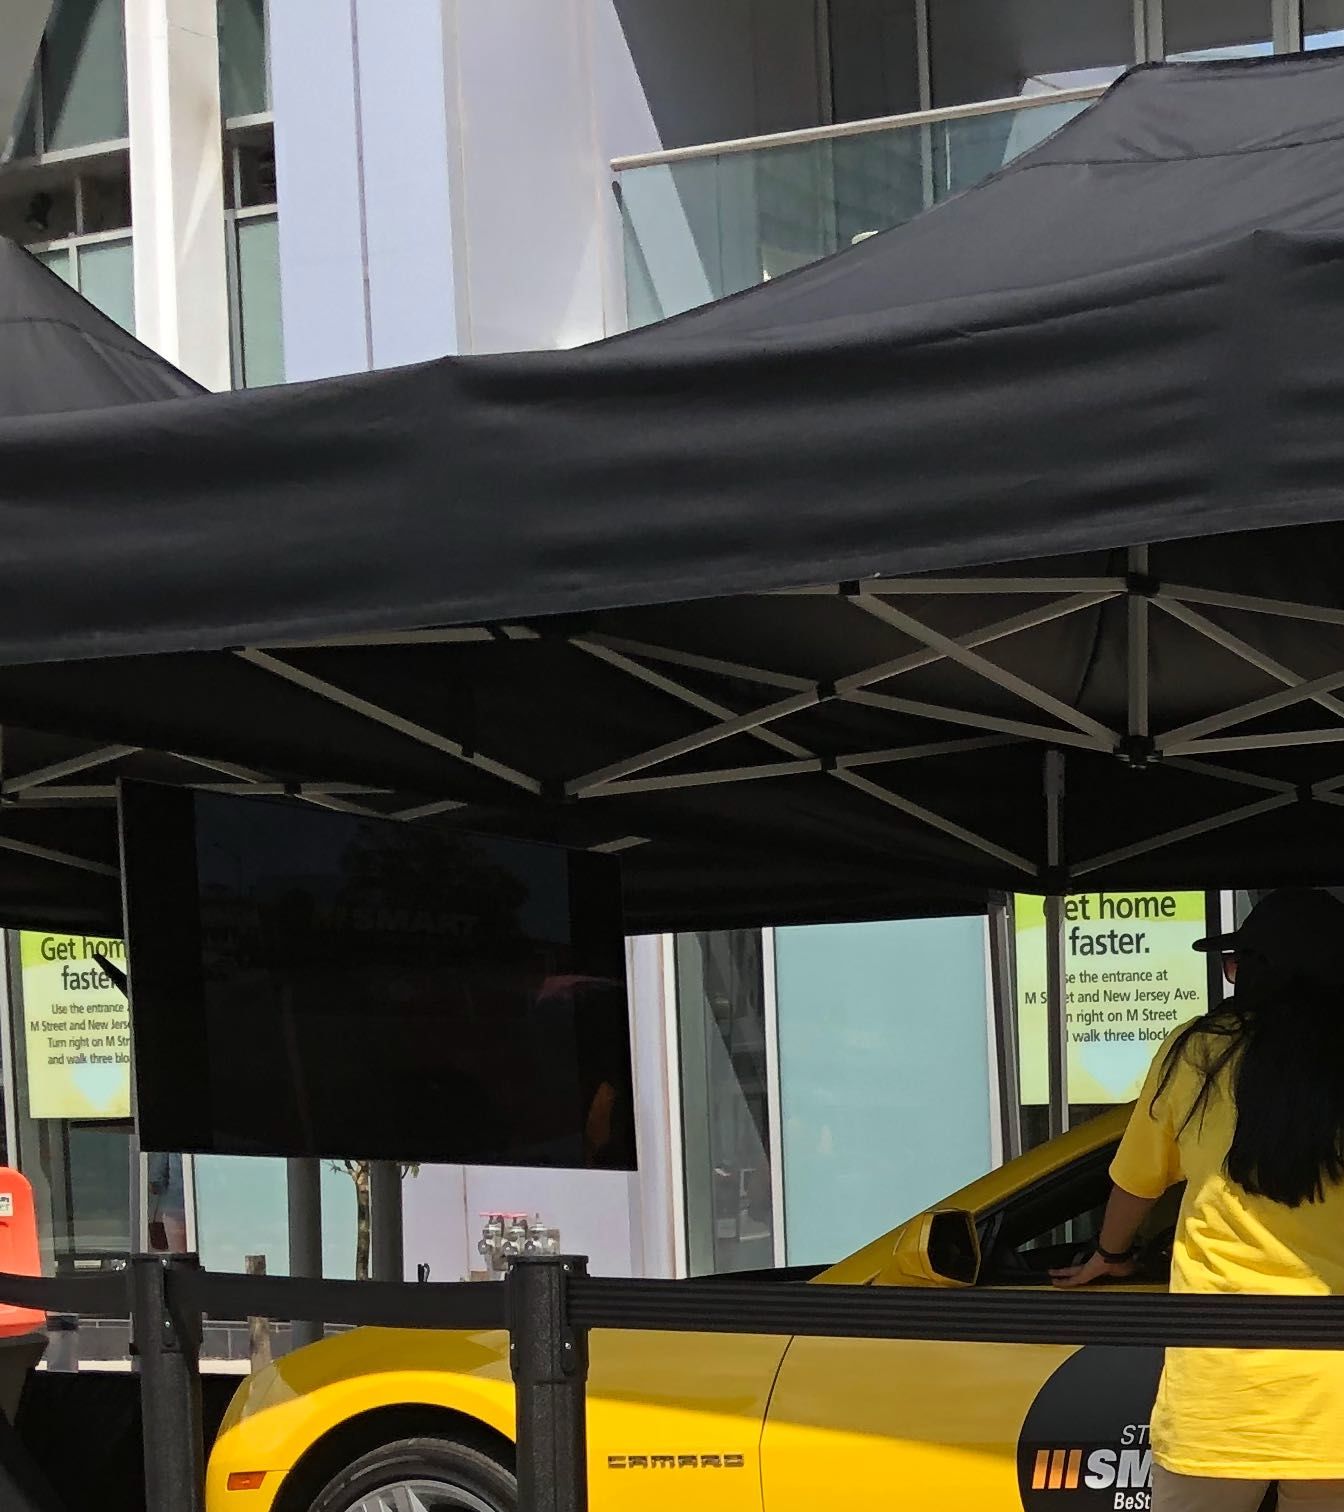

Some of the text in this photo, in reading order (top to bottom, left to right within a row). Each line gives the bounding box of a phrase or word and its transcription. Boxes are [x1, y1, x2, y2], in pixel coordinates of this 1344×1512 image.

[1100, 892, 1176, 920] home
[41, 936, 127, 961] Get hom
[1069, 926, 1150, 956] faster.
[61, 964, 115, 991] faste
[1079, 970, 1099, 983] the
[1101, 970, 1152, 983] entrance
[1156, 969, 1169, 981] at
[1024, 992, 1037, 1004] M
[1077, 990, 1100, 1003] and
[1103, 989, 1131, 1002] New
[1134, 988, 1170, 1004] Jersey
[1173, 987, 1201, 1001] Ave.
[51, 1003, 68, 1015] Use
[70, 1002, 84, 1014] the
[86, 1002, 124, 1014] entrance
[1076, 1009, 1104, 1026] right
[1107, 1011, 1123, 1022] on
[1126, 1009, 1138, 1021] M
[1142, 1009, 1178, 1021] Street
[30, 1021, 40, 1032] M
[41, 1020, 68, 1032] Street
[69, 1020, 86, 1031] and
[88, 1020, 108, 1031] New
[1072, 1029, 1100, 1042] walk
[1104, 1029, 1134, 1041] three
[1138, 1027, 1168, 1041] block
[48, 1036, 131, 1050] Turn right on M Str
[48, 1052, 131, 1065] and walk three blo
